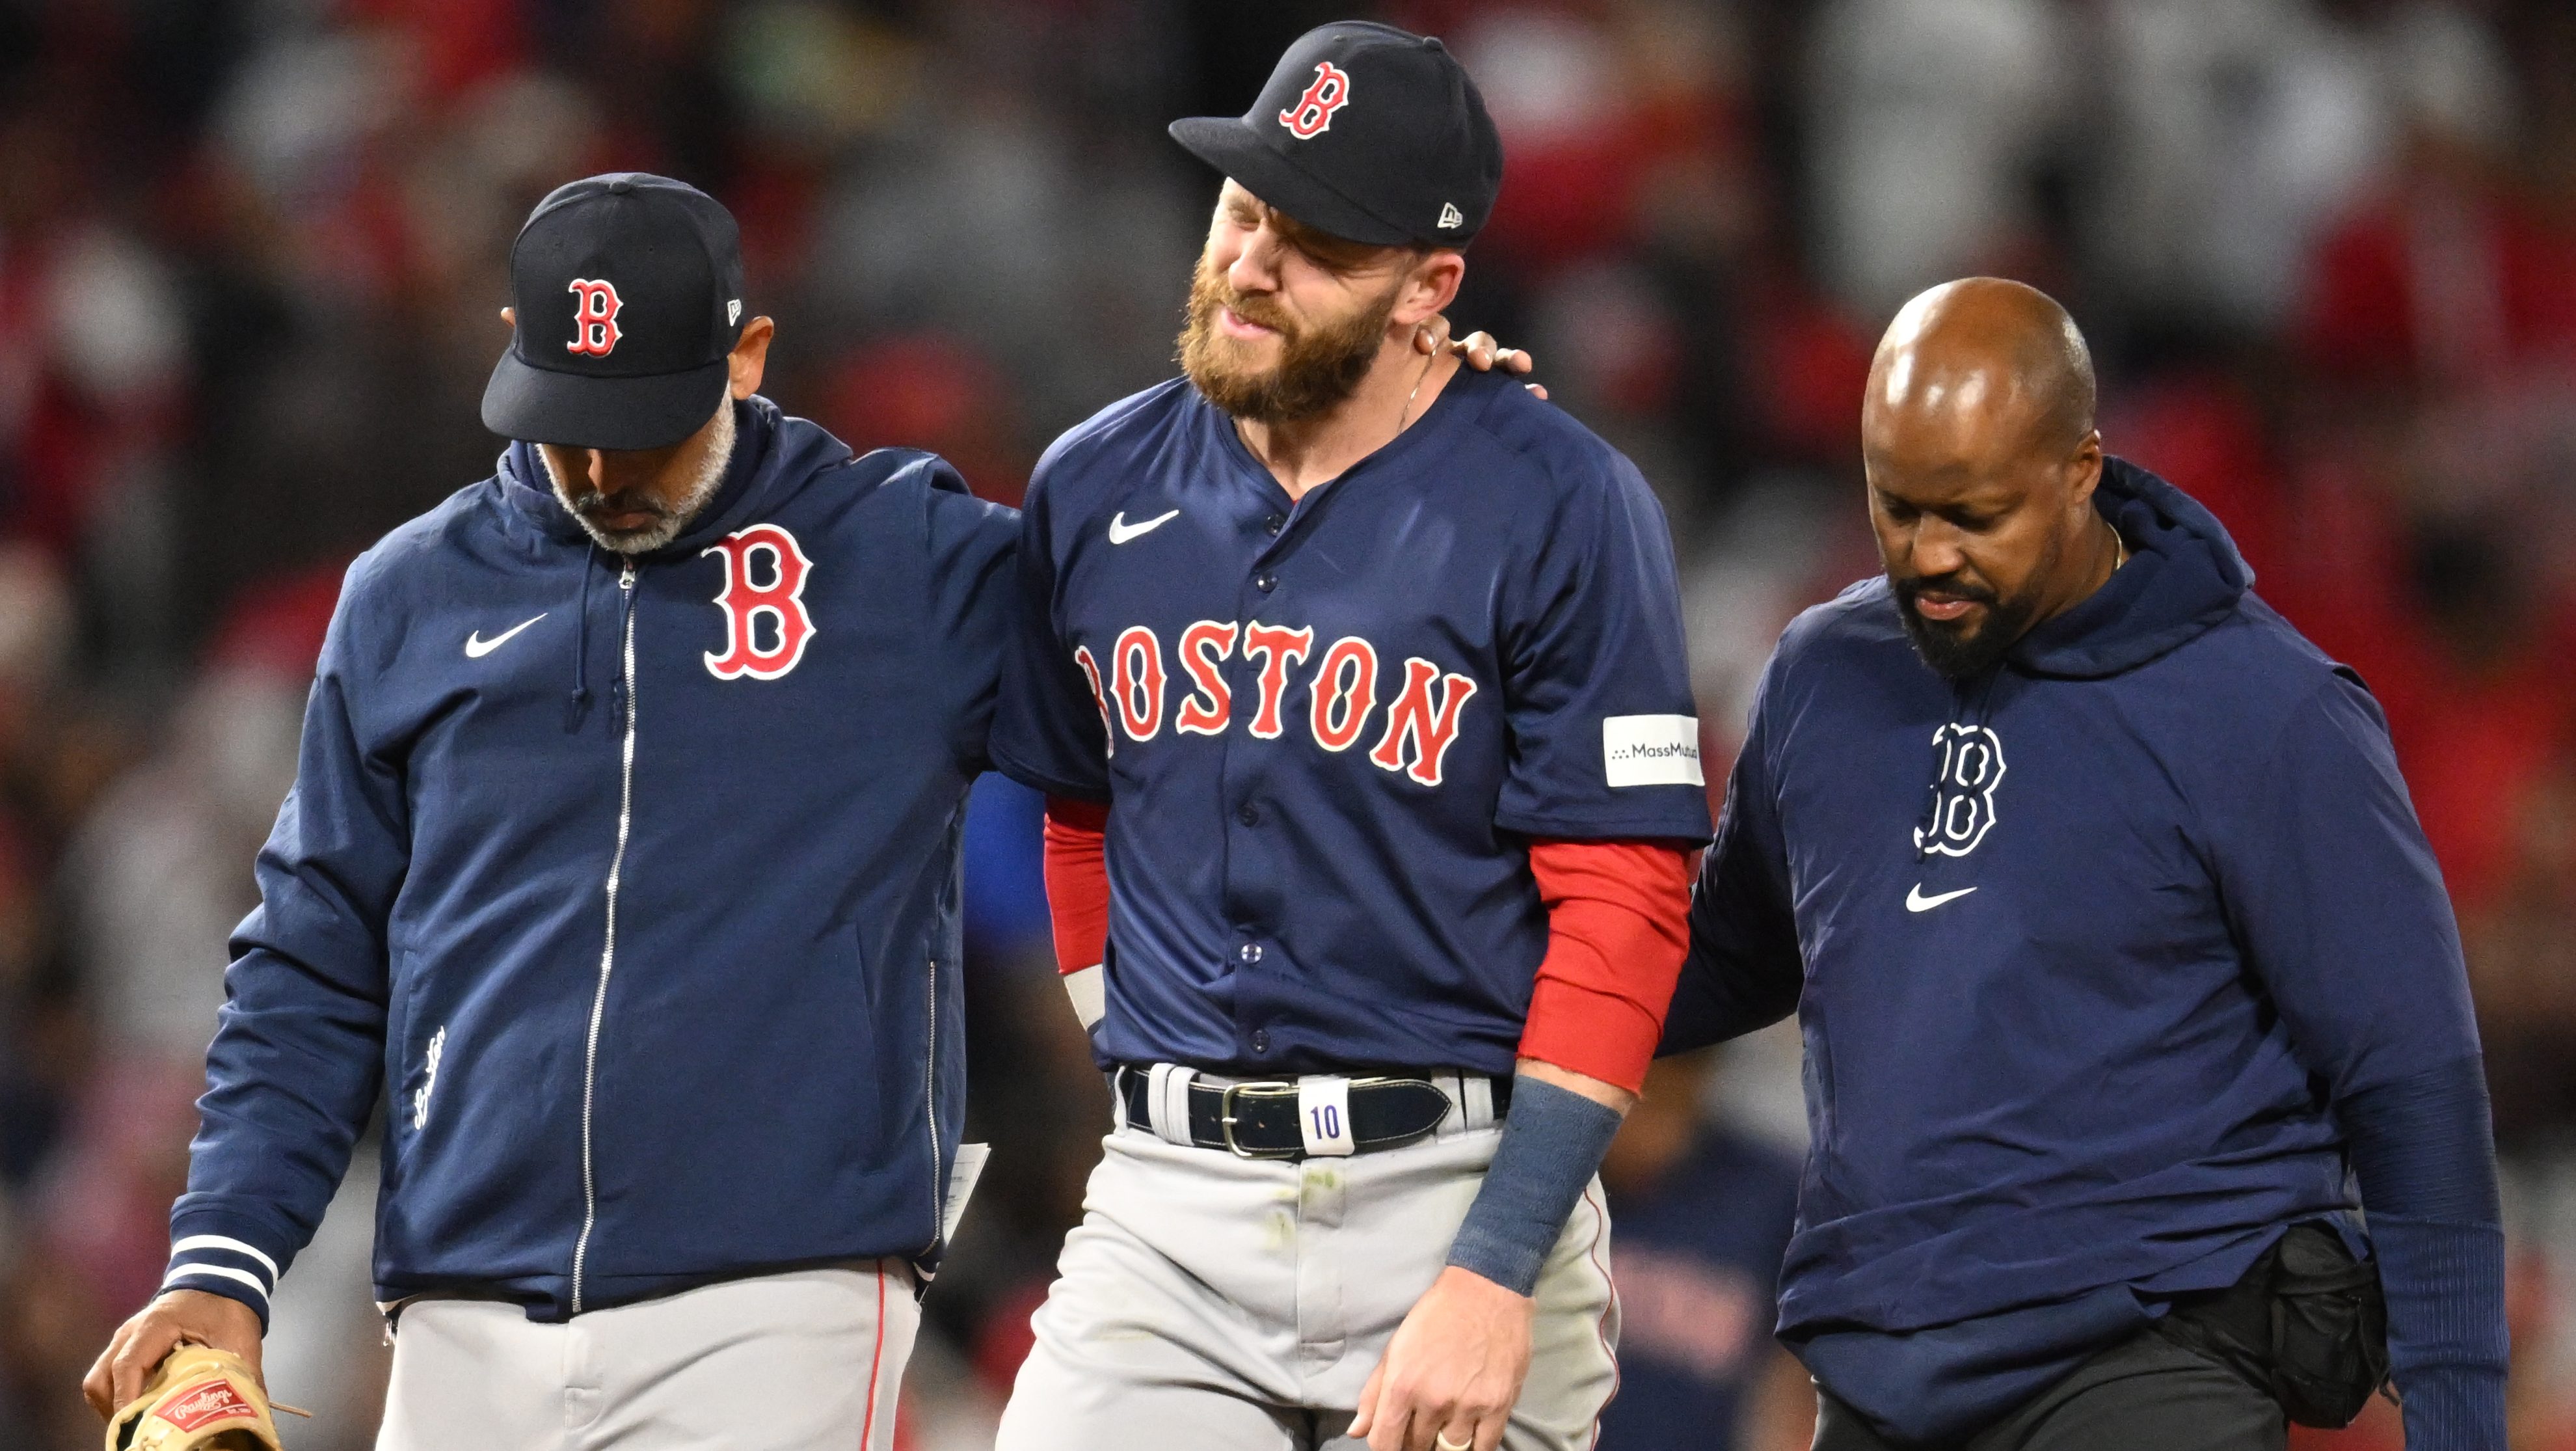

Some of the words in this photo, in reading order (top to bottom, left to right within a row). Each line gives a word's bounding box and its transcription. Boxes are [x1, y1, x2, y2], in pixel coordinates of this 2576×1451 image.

[1278, 61, 1350, 140] B
[567, 278, 624, 358] B
[700, 523, 817, 681] B
[1075, 619, 1478, 787] OSTON
[1310, 1104, 1341, 1140] 10
[174, 1389, 233, 1420] Rawlings
